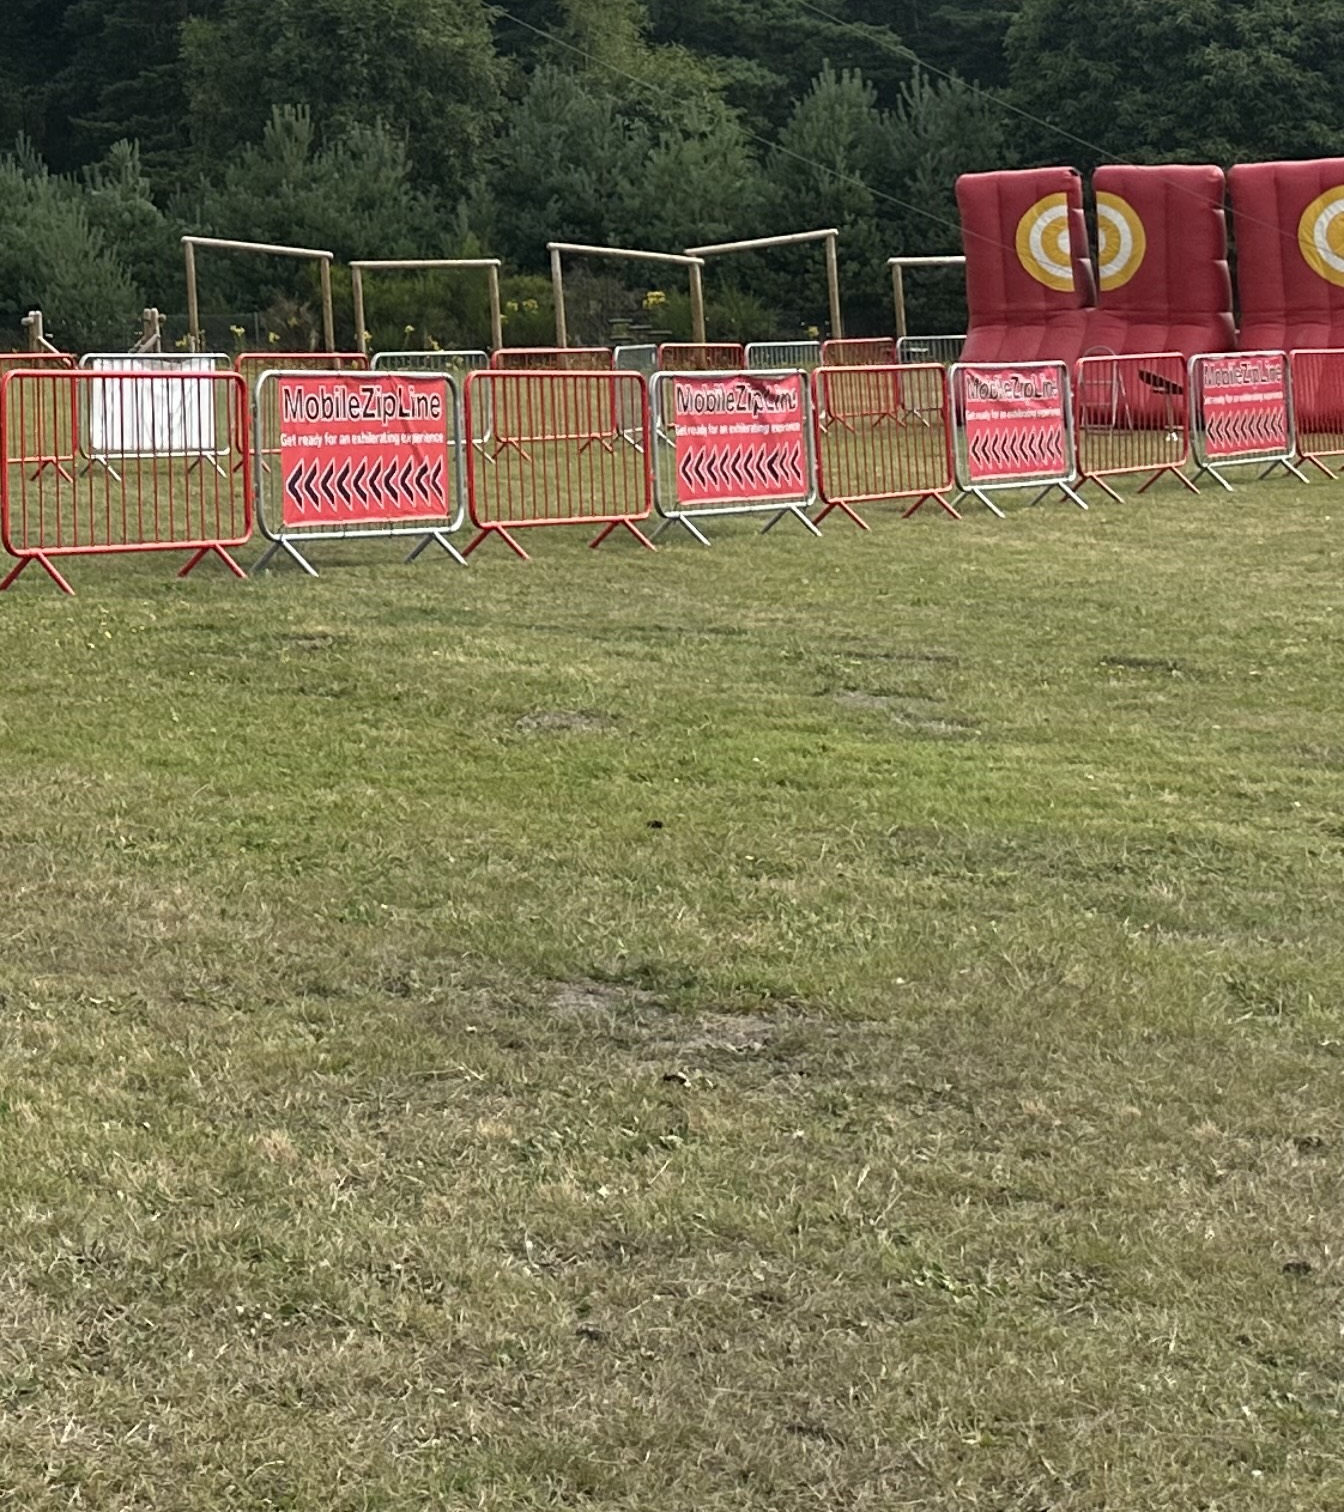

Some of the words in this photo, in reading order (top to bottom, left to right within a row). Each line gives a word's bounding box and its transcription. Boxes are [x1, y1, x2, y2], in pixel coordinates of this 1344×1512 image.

[282, 384, 443, 427] MobileZipLine
[280, 433, 297, 446] Get
[298, 433, 322, 448] ready
[324, 432, 337, 445] for
[339, 434, 350, 444] an
